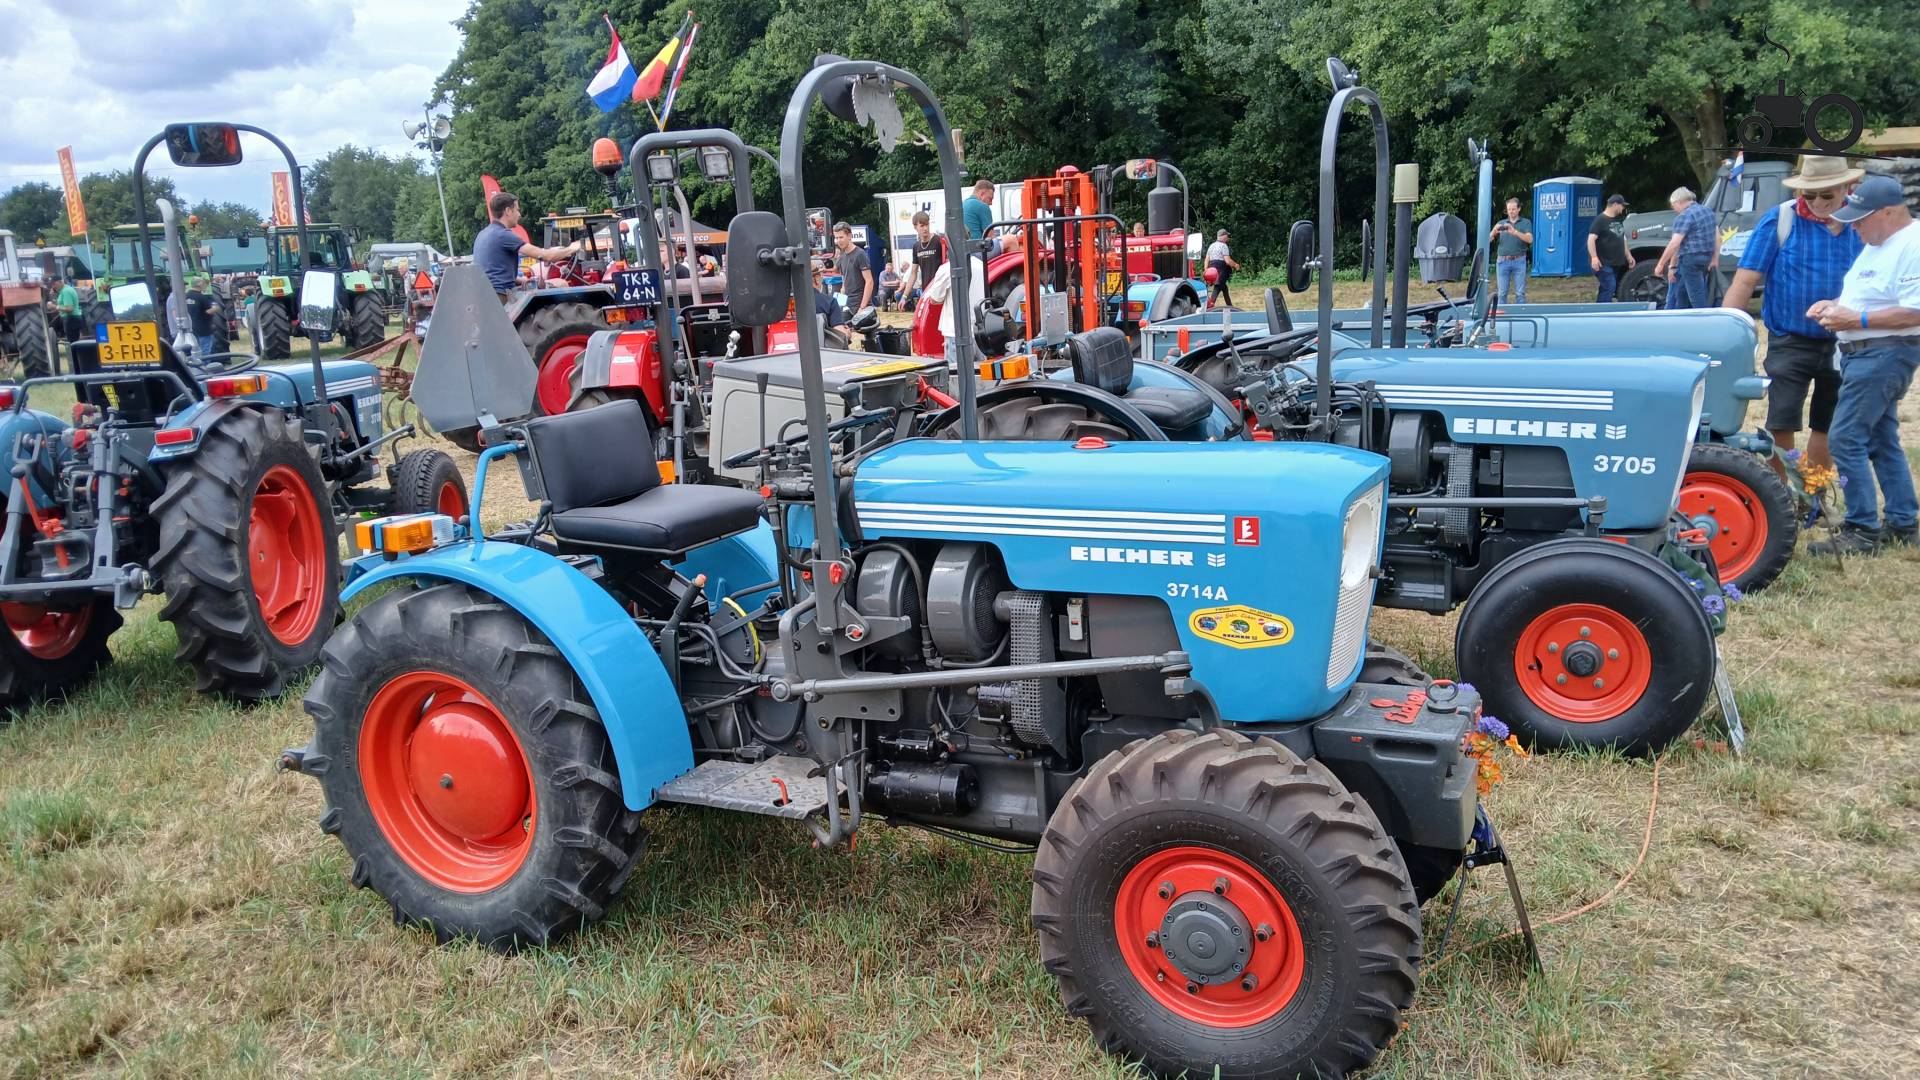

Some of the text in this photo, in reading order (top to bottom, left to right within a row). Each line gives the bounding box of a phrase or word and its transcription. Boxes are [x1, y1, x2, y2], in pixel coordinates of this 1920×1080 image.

[1541, 193, 1566, 205] HAKU
[622, 272, 651, 286] TKR
[623, 287, 656, 301] 64-N
[114, 326, 142, 341] T-3
[103, 344, 155, 360] 3-FHR
[1453, 418, 1597, 439] EICHER
[1593, 455, 1656, 474] 3705
[1070, 546, 1194, 566] EICHER
[1166, 582, 1228, 601] 3714A
